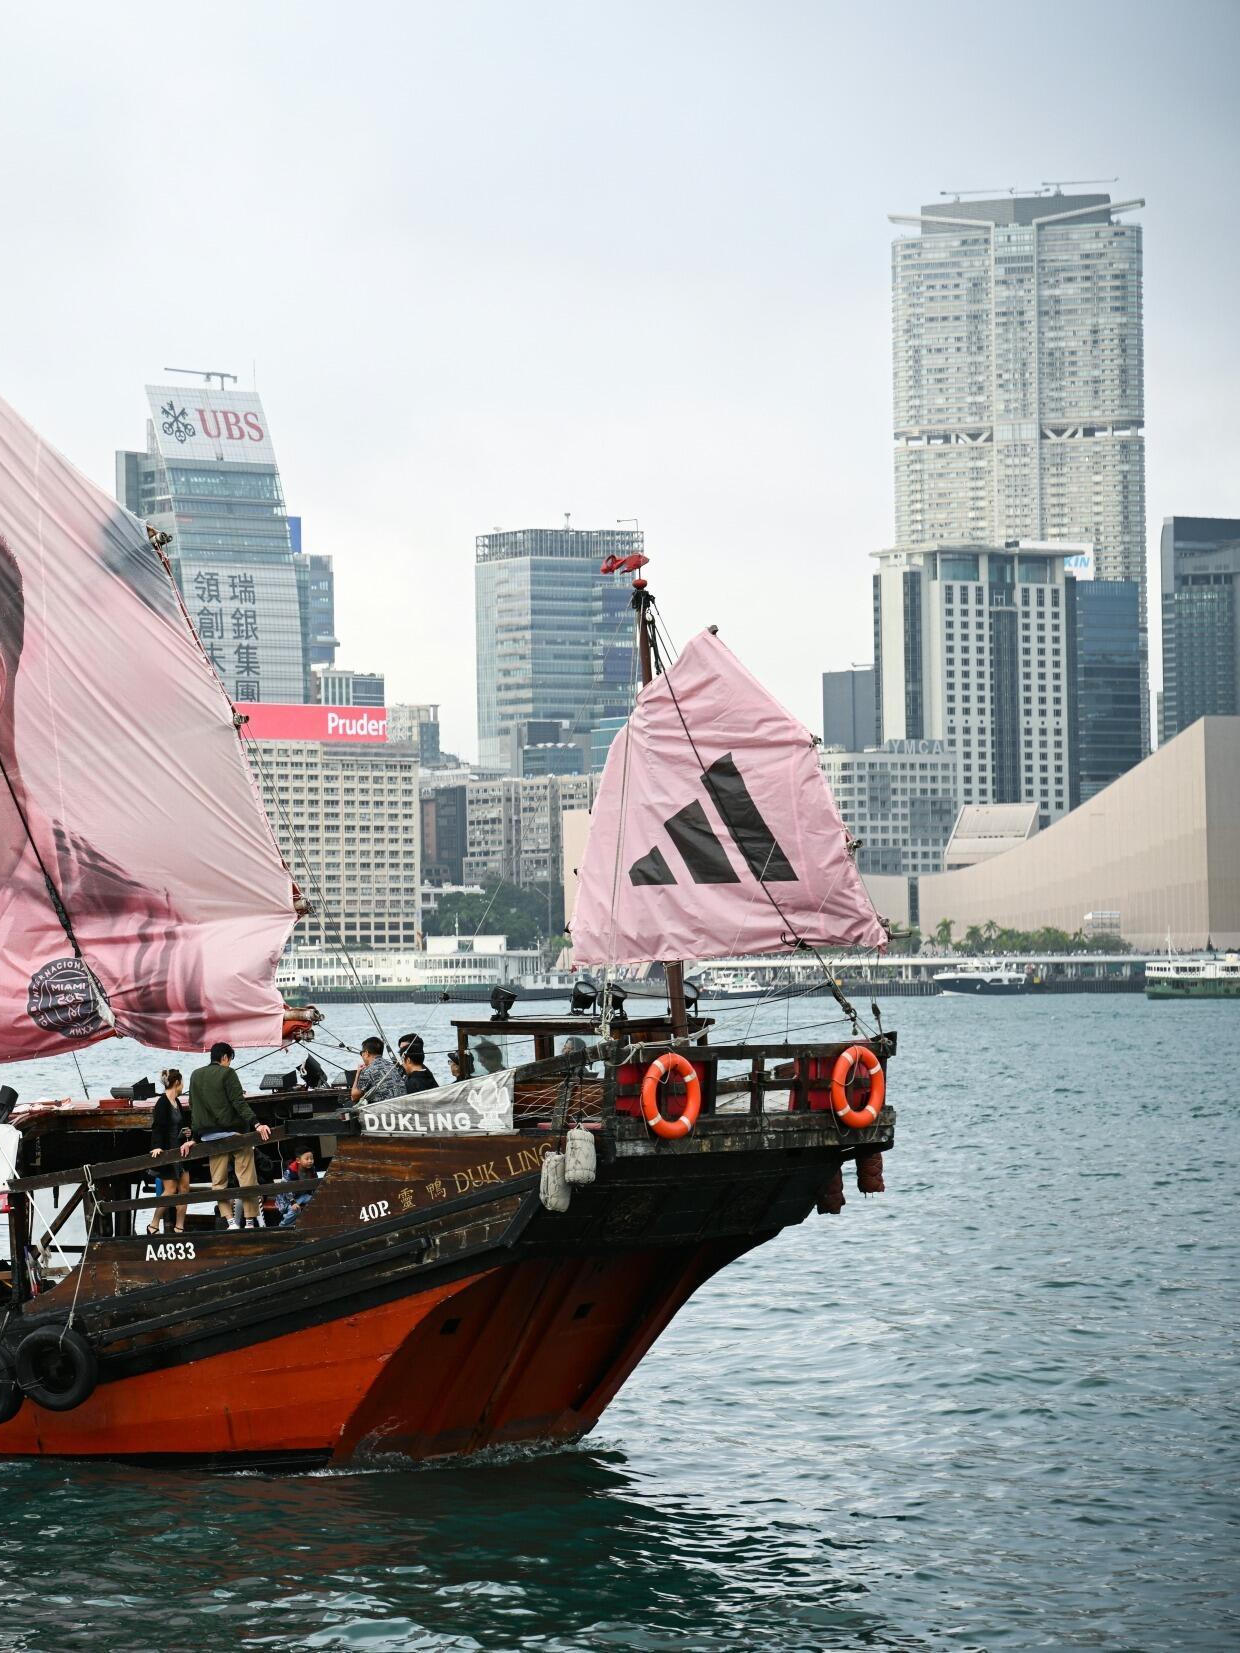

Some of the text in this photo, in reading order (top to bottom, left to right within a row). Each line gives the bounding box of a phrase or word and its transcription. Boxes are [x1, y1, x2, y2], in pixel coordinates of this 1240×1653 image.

[195, 408, 264, 442] UBS
[228, 572, 260, 702] 瑞銀集團
[890, 739, 945, 755] YMCA
[51, 983, 86, 992] MIAMI
[364, 1113, 471, 1131] DUKLING
[453, 1161, 504, 1193] DUK
[146, 1242, 196, 1261] A4833
